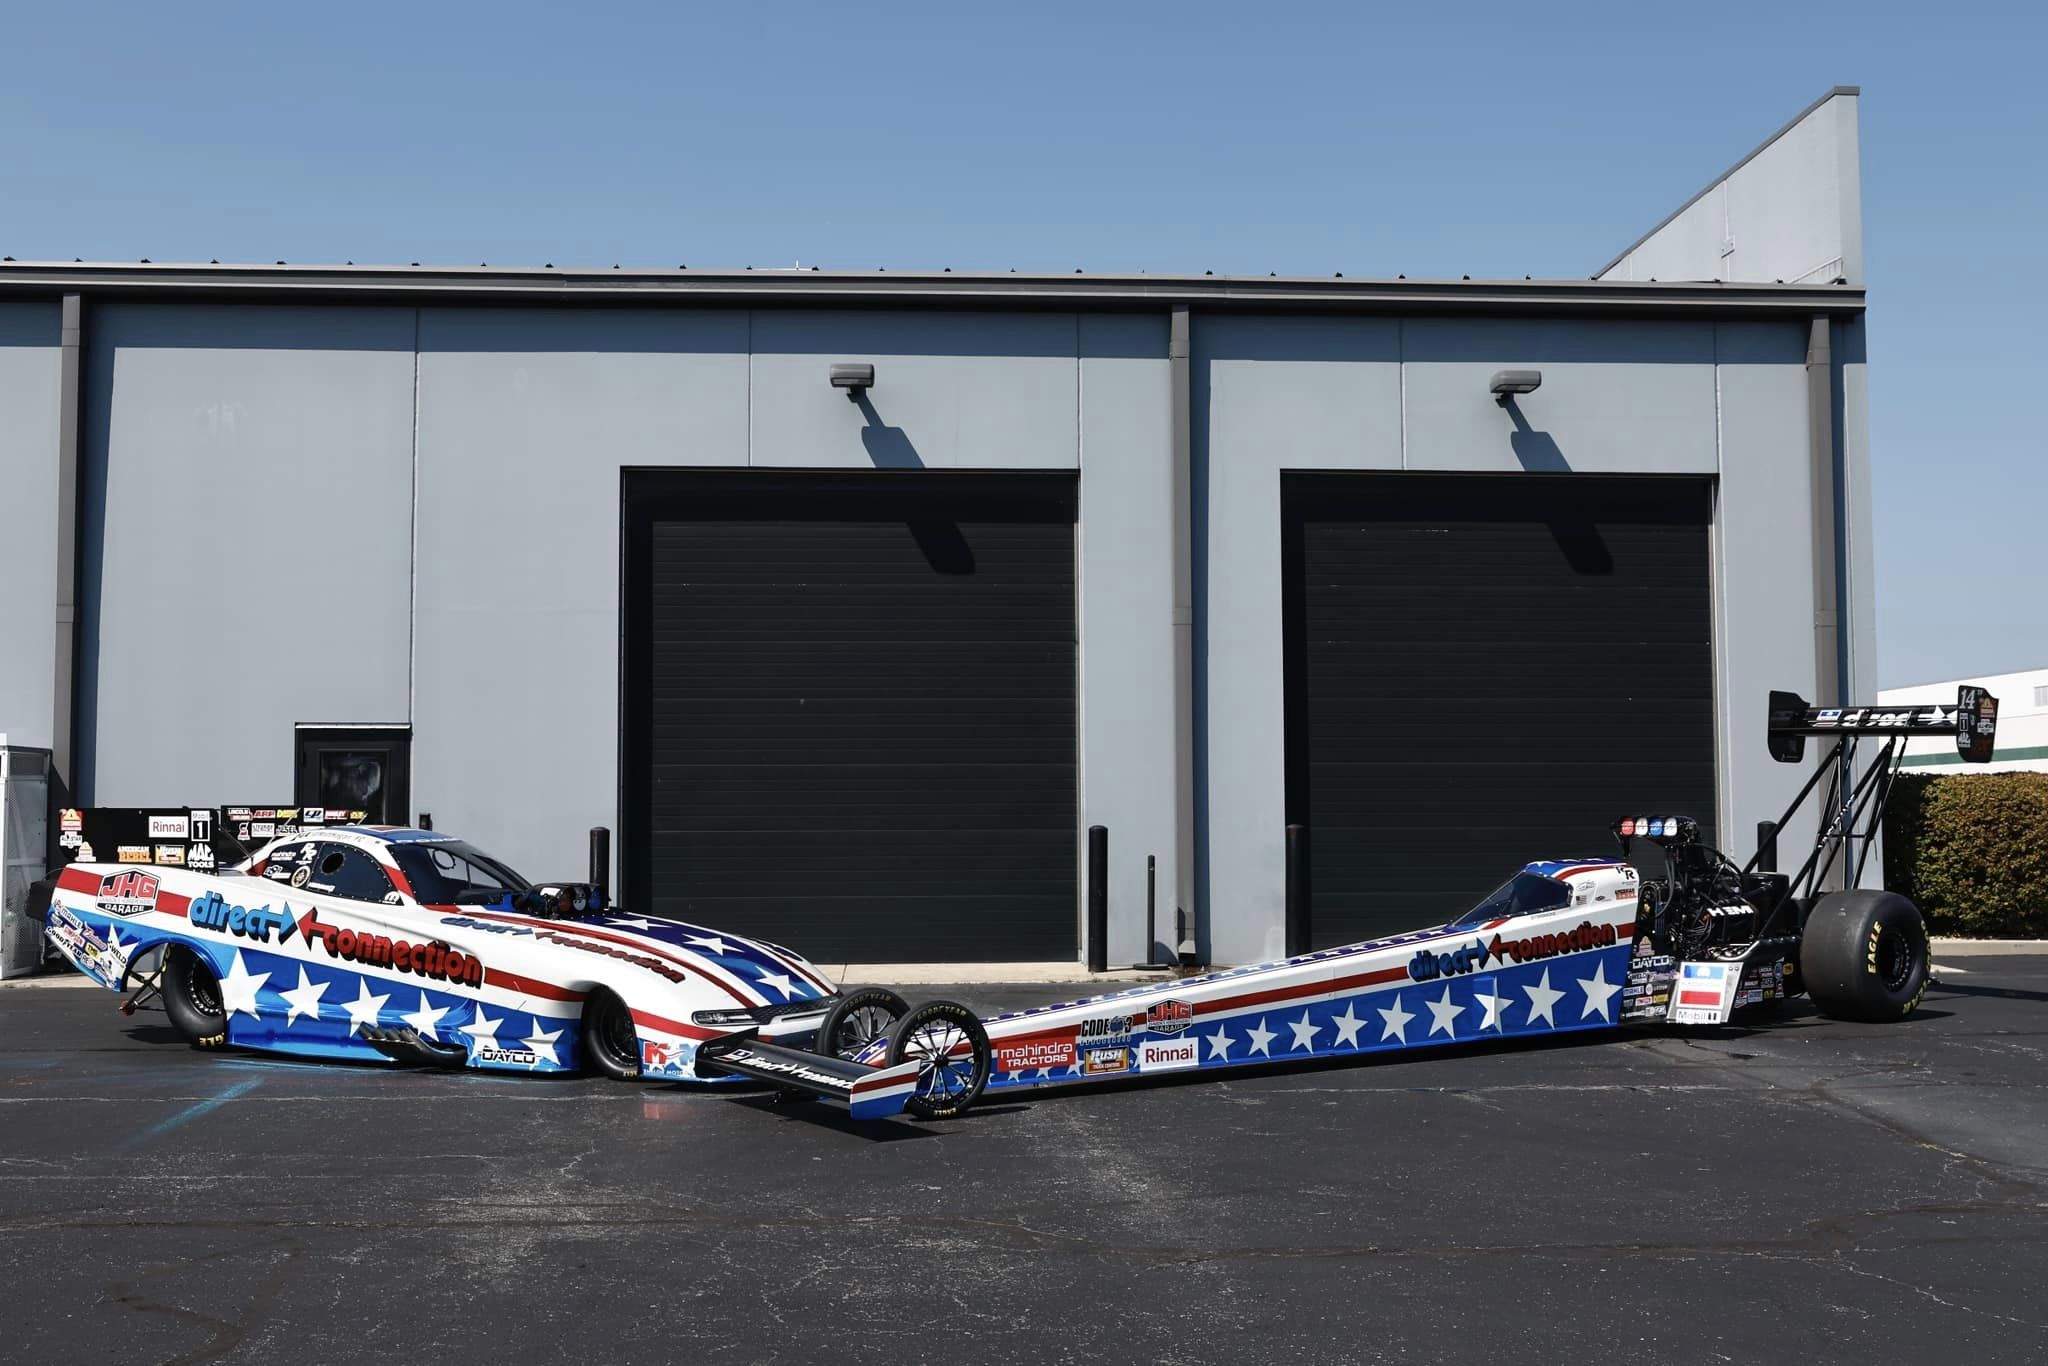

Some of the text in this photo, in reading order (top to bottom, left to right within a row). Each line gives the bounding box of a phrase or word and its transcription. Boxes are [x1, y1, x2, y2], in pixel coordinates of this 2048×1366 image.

[1959, 689, 1976, 710] 14
[152, 821, 185, 833] Rinnai
[188, 843, 214, 861] MAC
[101, 873, 157, 897] JHG
[105, 903, 145, 914] GARAGE
[1707, 905, 1754, 917] HEMI
[47, 926, 82, 959] GOODYEAR
[190, 889, 485, 989] direct connection
[1867, 920, 1882, 974] EAGLE
[110, 946, 127, 964] WELD
[551, 934, 687, 985] connection
[1409, 942, 1476, 983] direct
[1507, 920, 1617, 964] connection
[1632, 955, 1670, 970] DAYCO
[1148, 1001, 1190, 1022] JHG
[1081, 1016, 1133, 1037] CODE 3
[1153, 1024, 1184, 1032] GARAGE
[482, 1048, 536, 1065] DAYCO
[1001, 1041, 1073, 1059] mahindra
[1091, 1049, 1122, 1063] RUSH
[1145, 1044, 1193, 1064] Rinnai
[1007, 1054, 1068, 1067] TRACTORS
